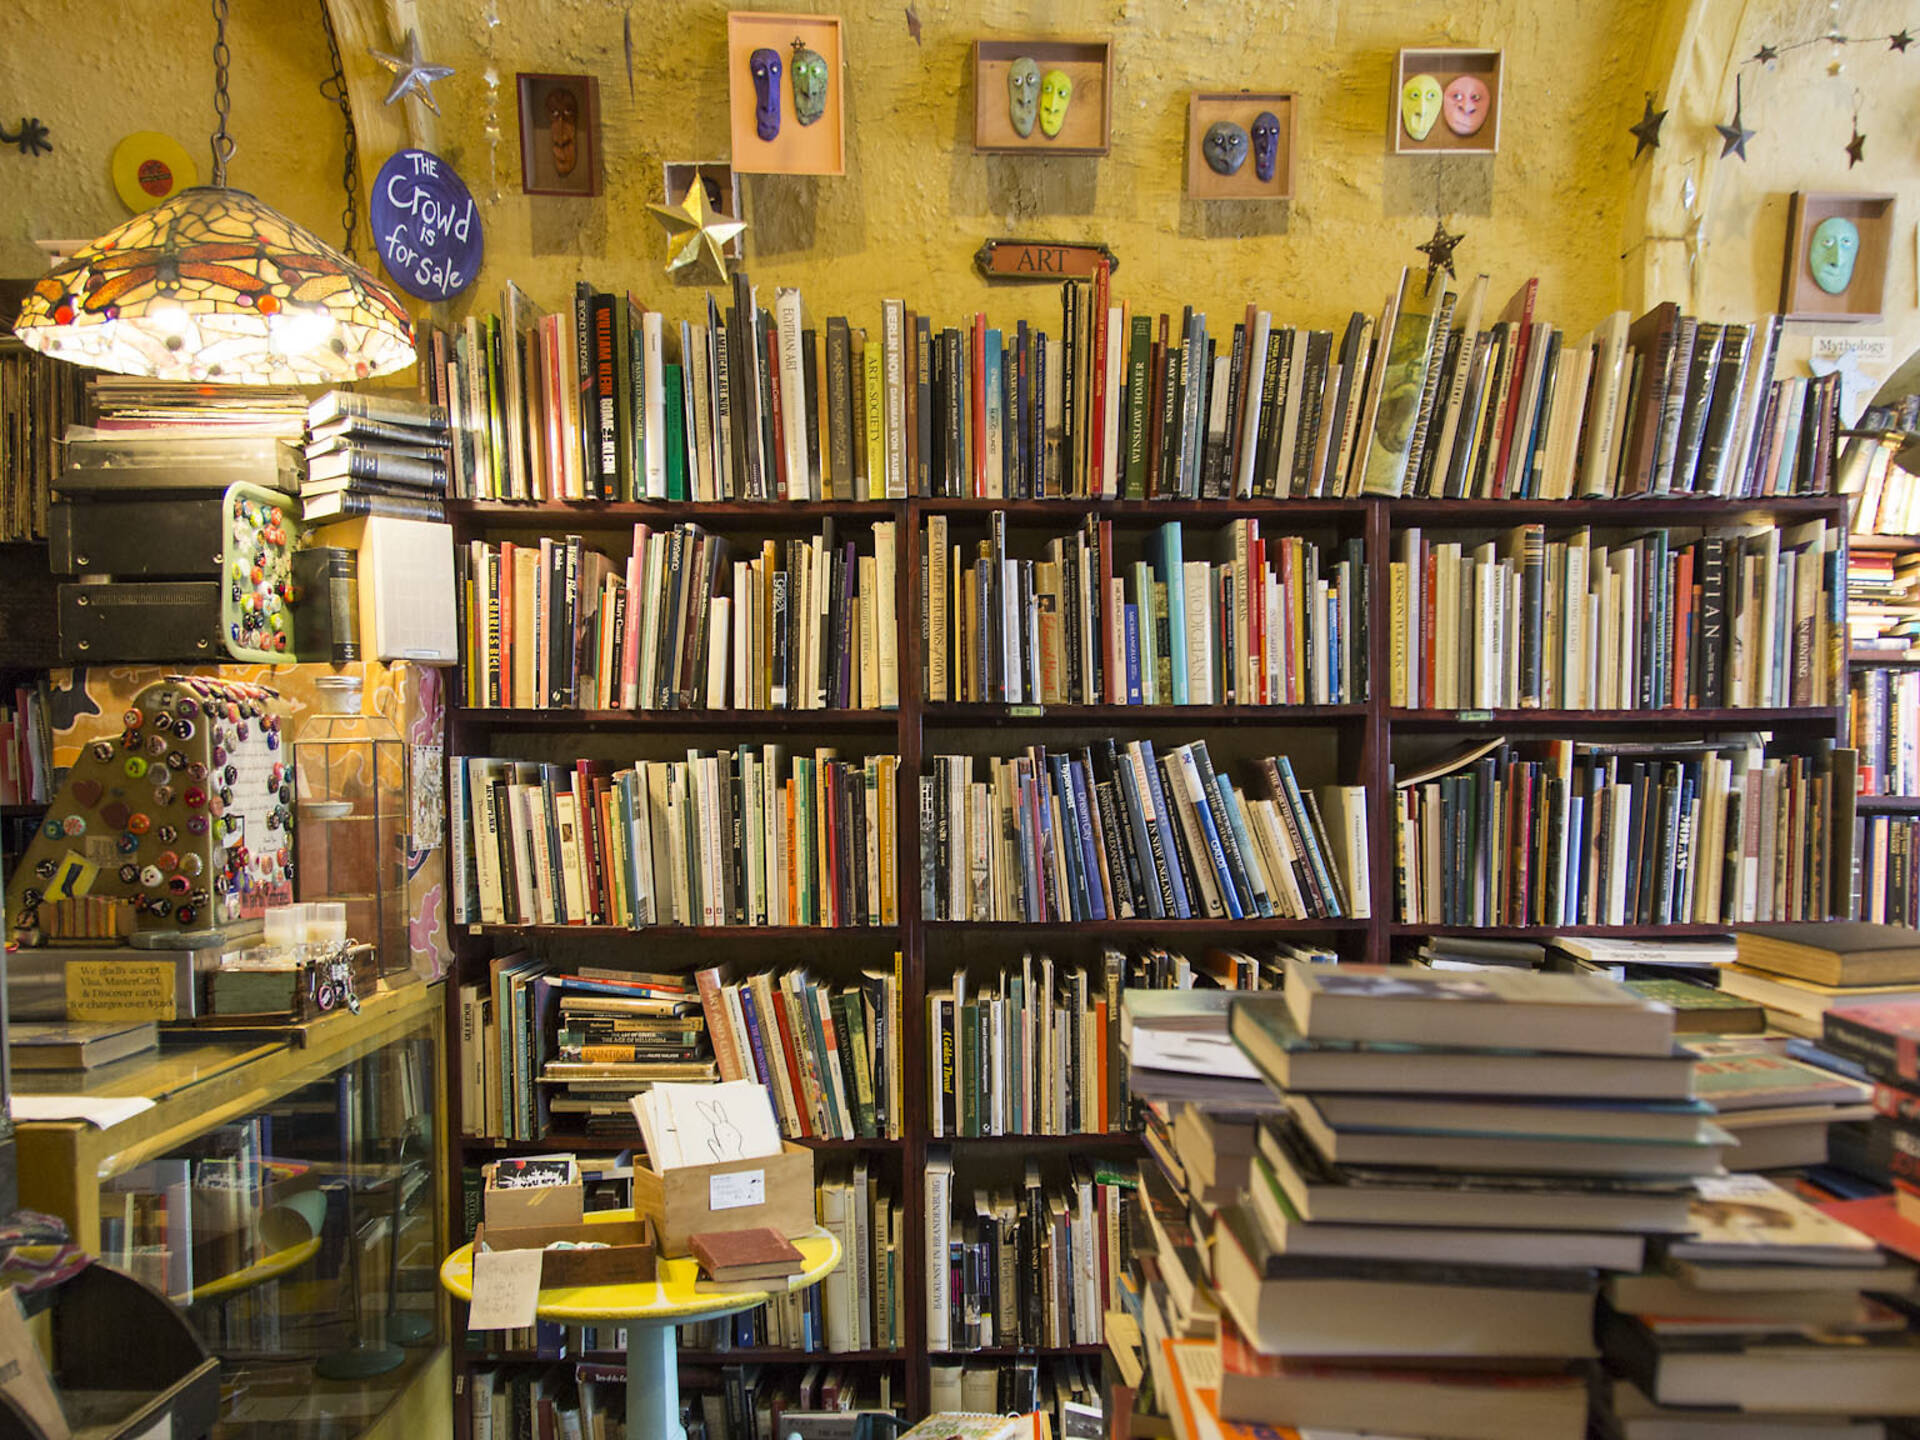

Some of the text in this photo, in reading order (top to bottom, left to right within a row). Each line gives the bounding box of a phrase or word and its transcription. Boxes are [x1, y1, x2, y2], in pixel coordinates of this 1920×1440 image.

[405, 153, 439, 179] THE
[385, 224, 419, 268] for
[420, 224, 436, 246] is
[1016, 248, 1072, 272] ART
[597, 308, 612, 361] WILLIAM
[783, 308, 798, 372] EGYPTIAN ART
[886, 305, 900, 350] BERLIN
[599, 363, 614, 396] KLEIN
[718, 334, 730, 417] AMERICAN ART NOW
[887, 353, 899, 385] NOW
[1165, 358, 1177, 424] MAY STEVENS
[868, 356, 882, 443] ART SOCIETY
[889, 387, 899, 428] DAGMAR
[1133, 361, 1145, 464] WINSLOW HOMER
[890, 430, 899, 451] VON
[933, 542, 945, 594] COMPLETE
[1396, 567, 1406, 617] JACKSON
[1704, 541, 1722, 639] TITIAN
[488, 597, 500, 673] CHARLES BELL
[614, 598, 625, 644] Mary Cassatt
[933, 597, 945, 645] ETCHINGS
[1190, 584, 1206, 681] MODIGLIANI
[934, 657, 945, 686] GOYA
[1077, 792, 1092, 841] Dream City
[1098, 787, 1113, 829] NATHANIEL
[1106, 831, 1121, 876] ALEXANDER
[1148, 823, 1173, 904] IN NEW ENGLAND
[708, 989, 720, 1012] ART
[943, 1037, 952, 1064] Golden
[931, 1179, 942, 1310] BAUKUNST IN BRANDENBURG
